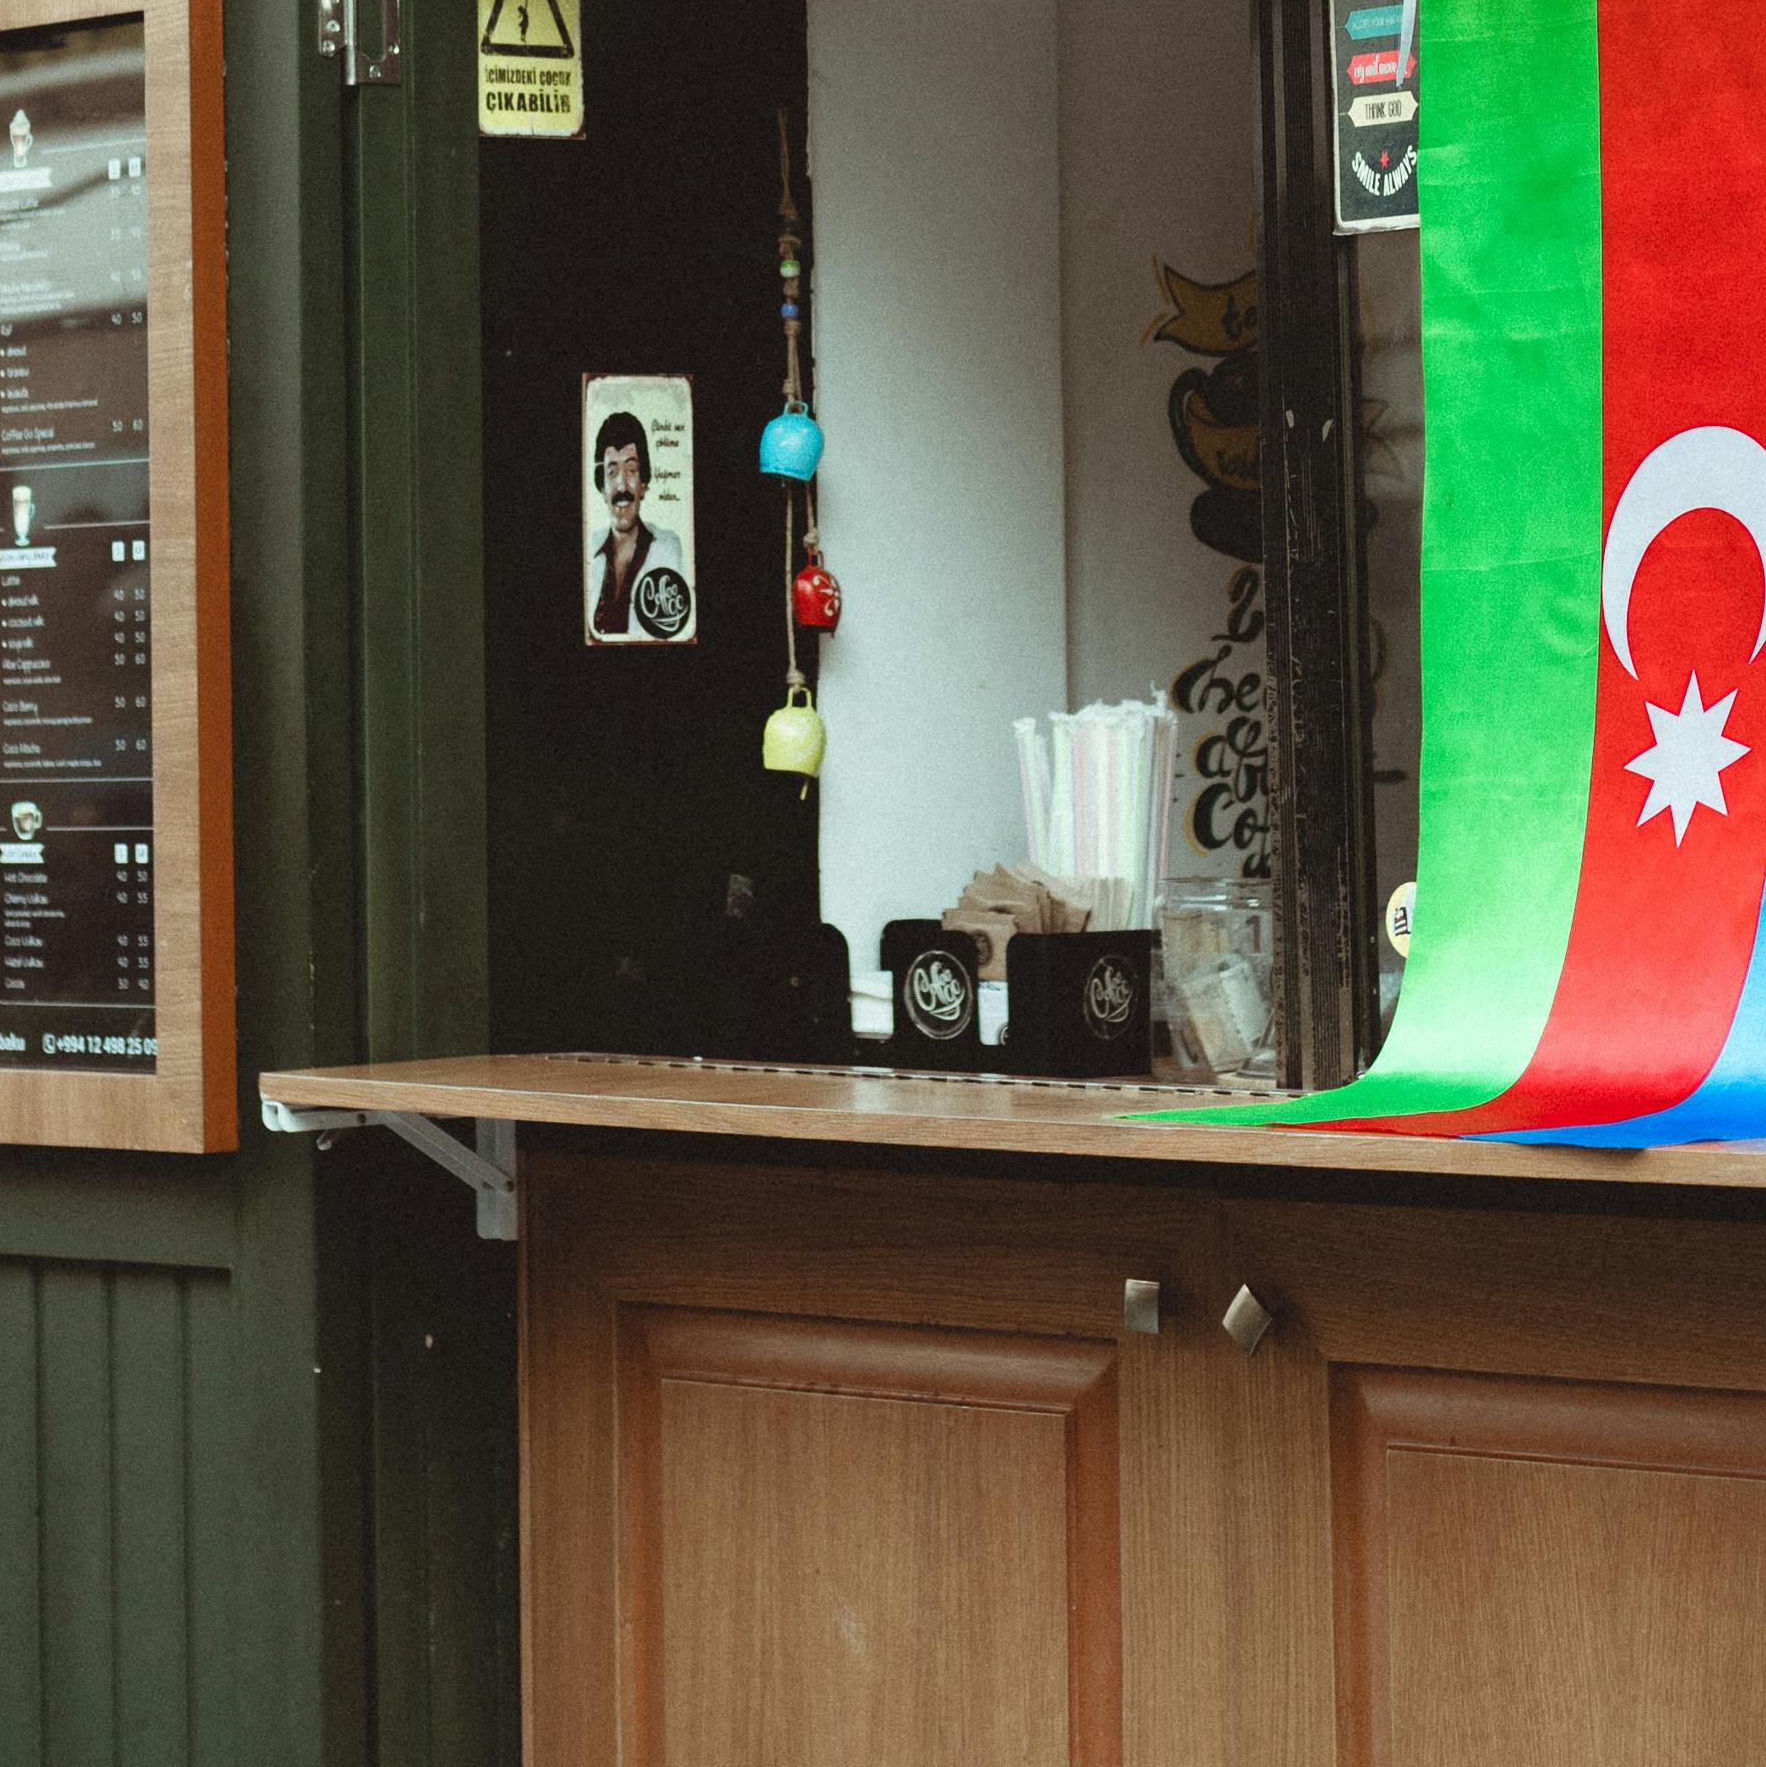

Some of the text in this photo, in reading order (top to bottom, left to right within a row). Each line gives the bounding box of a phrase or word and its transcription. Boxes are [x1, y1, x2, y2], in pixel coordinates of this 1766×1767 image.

[1365, 101, 1402, 120] THANK GOD
[1352, 145, 1417, 196] SMILE ALWAYS
[87, 1036, 102, 1053] 12
[127, 1037, 142, 1054] 25
